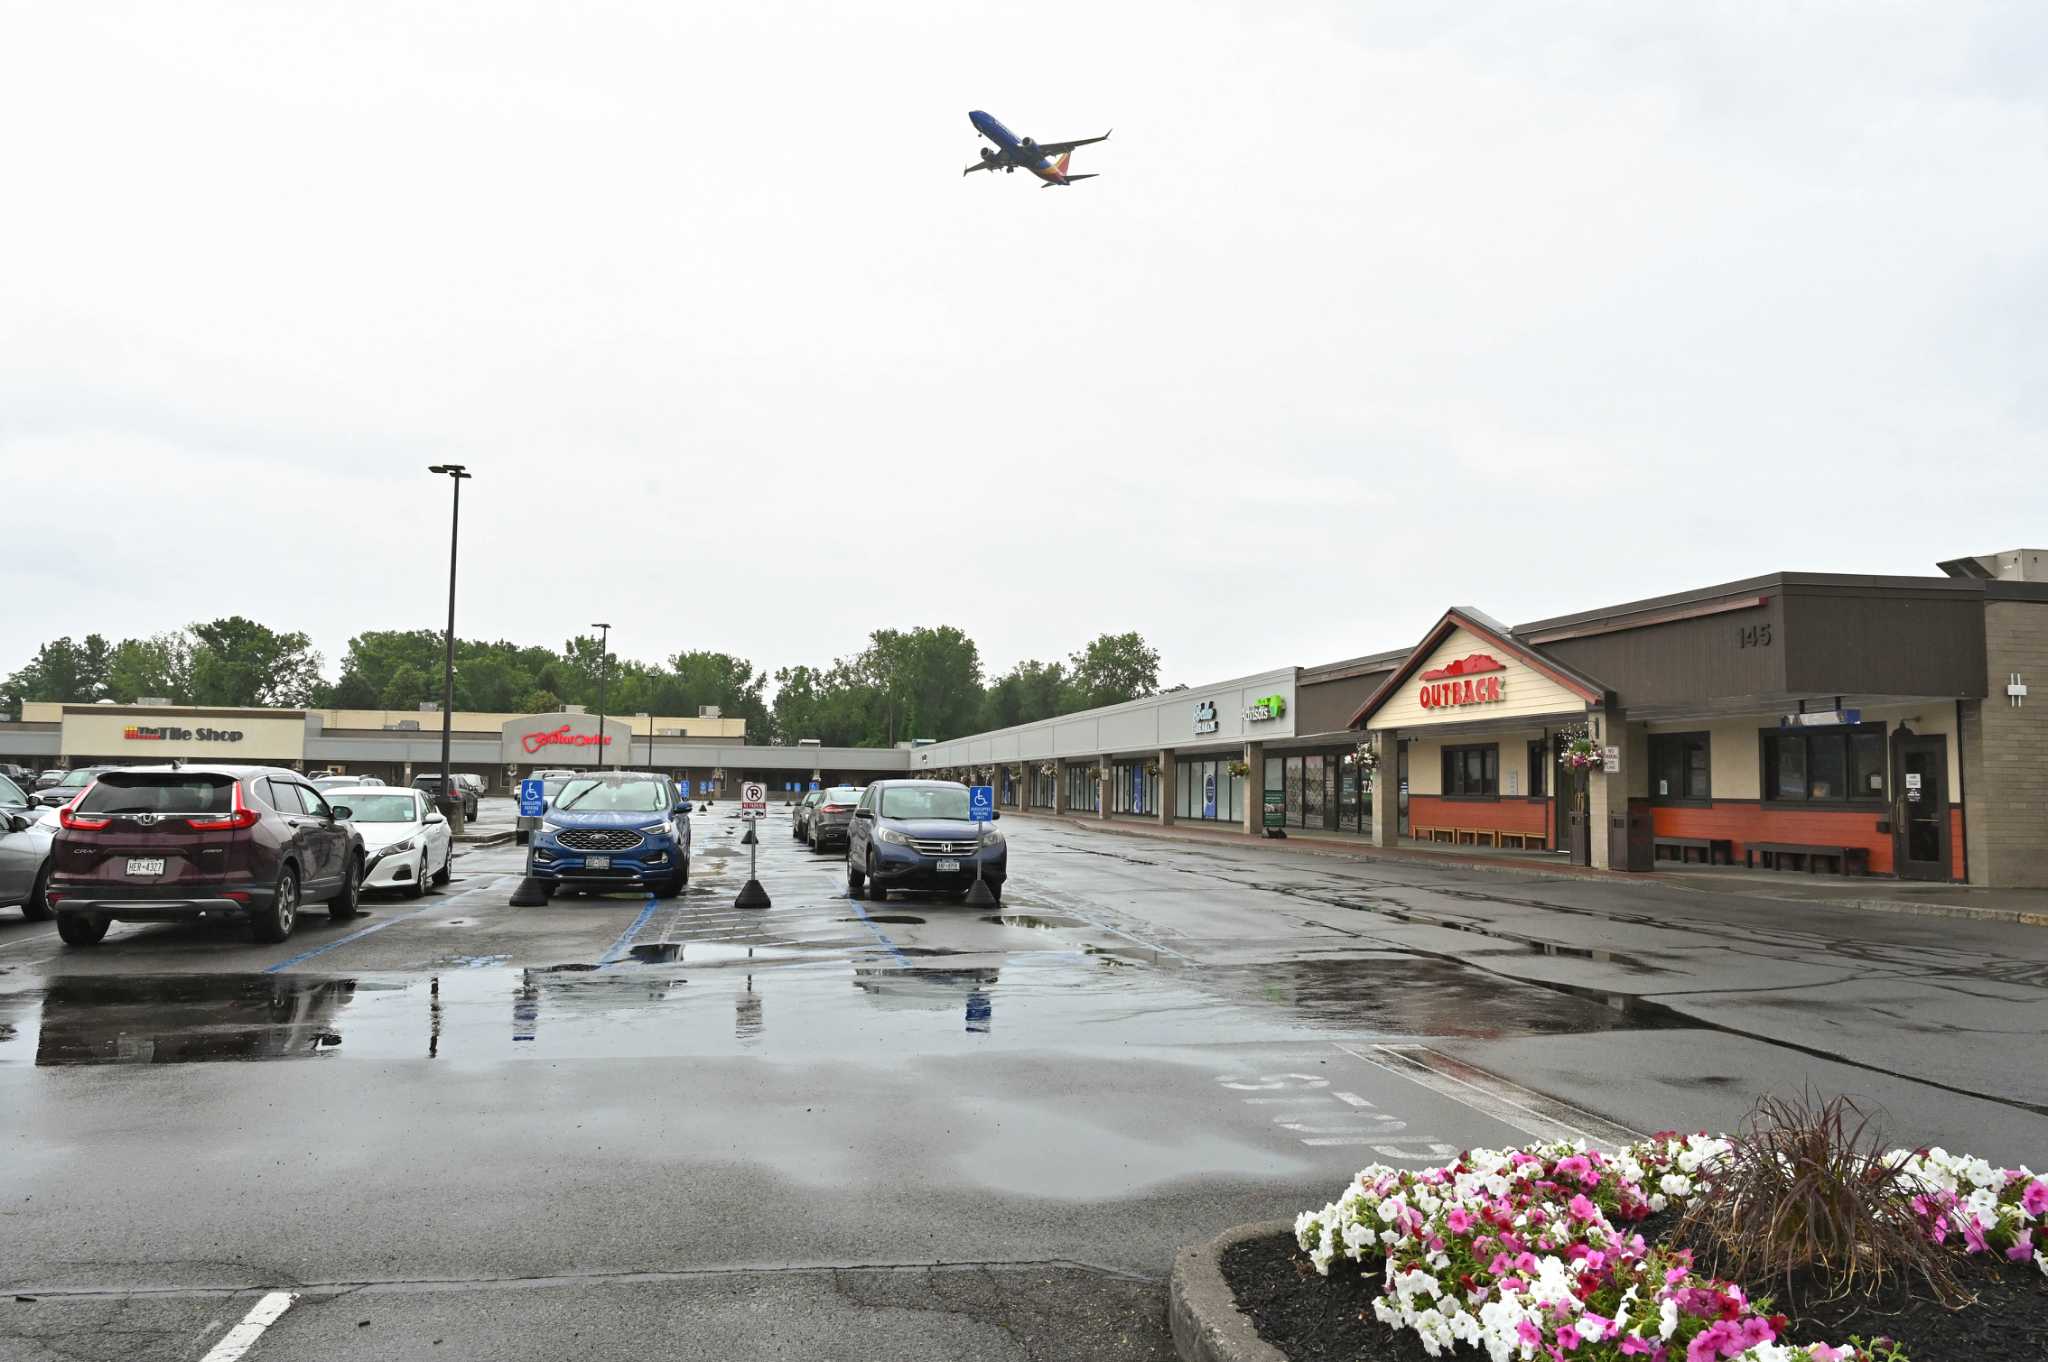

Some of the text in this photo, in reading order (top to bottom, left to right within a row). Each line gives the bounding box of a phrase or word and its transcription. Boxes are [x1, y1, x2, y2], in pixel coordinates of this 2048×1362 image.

[1740, 624, 1772, 648] 145
[1420, 676, 1500, 708] OUTBACK
[158, 727, 192, 741] Tile
[195, 728, 243, 743] Shop
